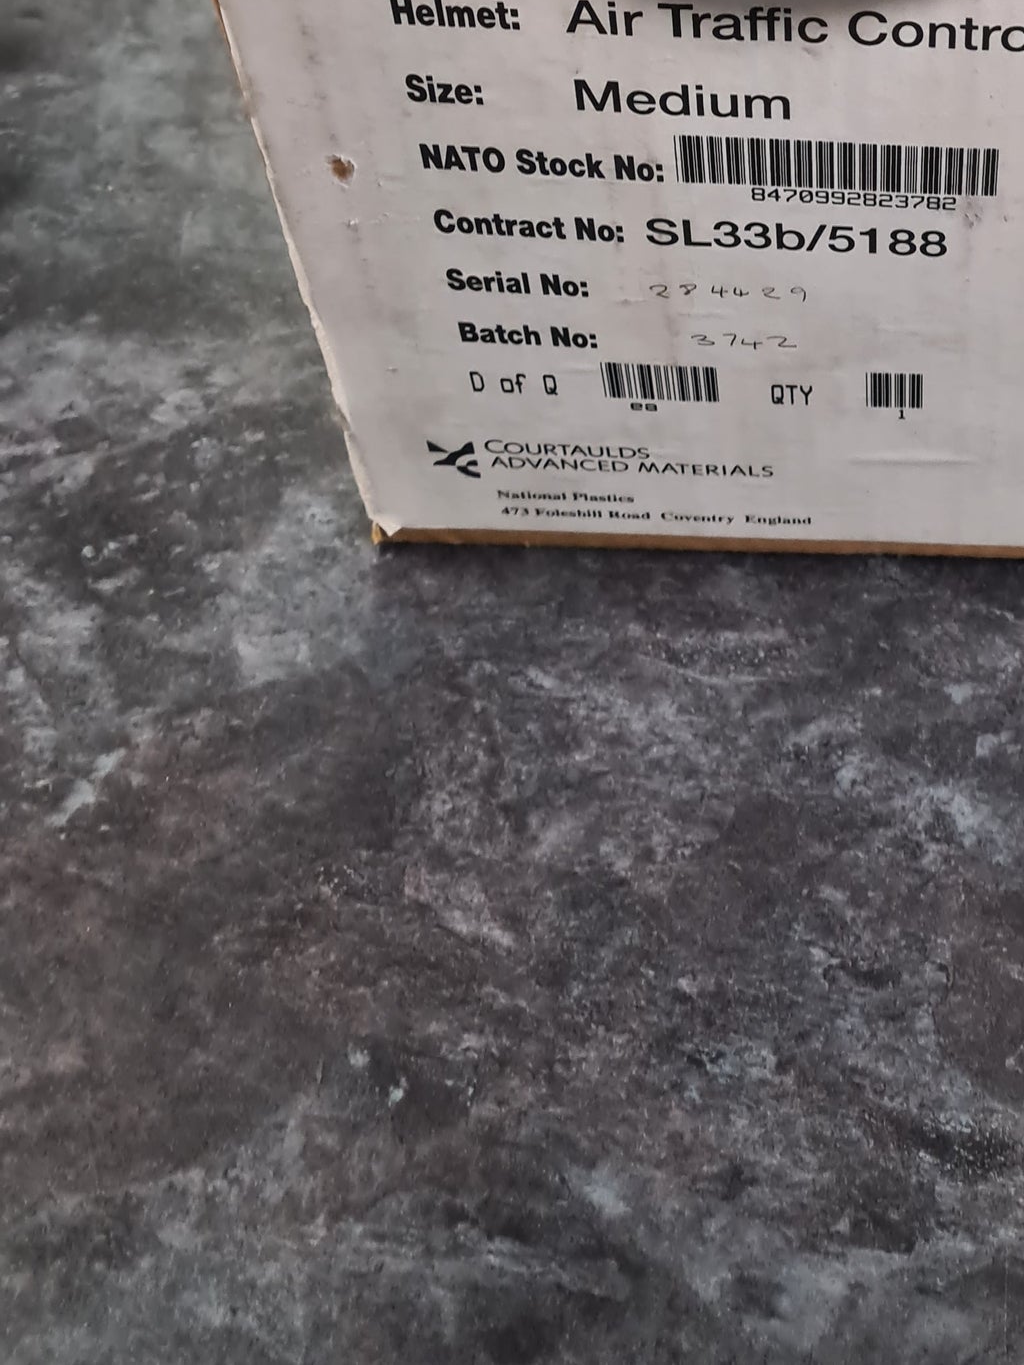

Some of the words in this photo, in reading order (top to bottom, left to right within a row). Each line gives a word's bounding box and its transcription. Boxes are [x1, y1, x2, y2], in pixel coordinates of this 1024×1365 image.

[566, 0, 643, 37] Air
[658, 3, 828, 43] Traffic
[405, 73, 484, 105] Size:
[574, 79, 791, 119] Medium
[419, 143, 506, 174] NATO
[515, 148, 605, 179] Stock
[614, 154, 664, 183] No:
[751, 187, 957, 211] 8470992823782
[433, 208, 566, 240] Contract
[574, 216, 625, 243] No:
[645, 218, 948, 257] SL33b/5188
[445, 268, 530, 295] Serial
[539, 273, 589, 298] No:
[457, 321, 542, 347] Batch
[550, 326, 598, 349] No:
[690, 333, 797, 351] 3742
[469, 371, 485, 393] D
[500, 373, 527, 395] of
[543, 374, 558, 396] Q
[770, 384, 813, 406] QTY
[898, 409, 906, 420] 1
[484, 439, 650, 460] COURTAULDS
[491, 457, 629, 473] ADVANCED
[638, 462, 774, 478] MATERIALS
[497, 490, 567, 502] National
[572, 492, 635, 504] Plastics
[501, 506, 530, 517] 473
[608, 510, 651, 521] Road
[660, 511, 735, 526] Coventry
[744, 514, 812, 527] England
